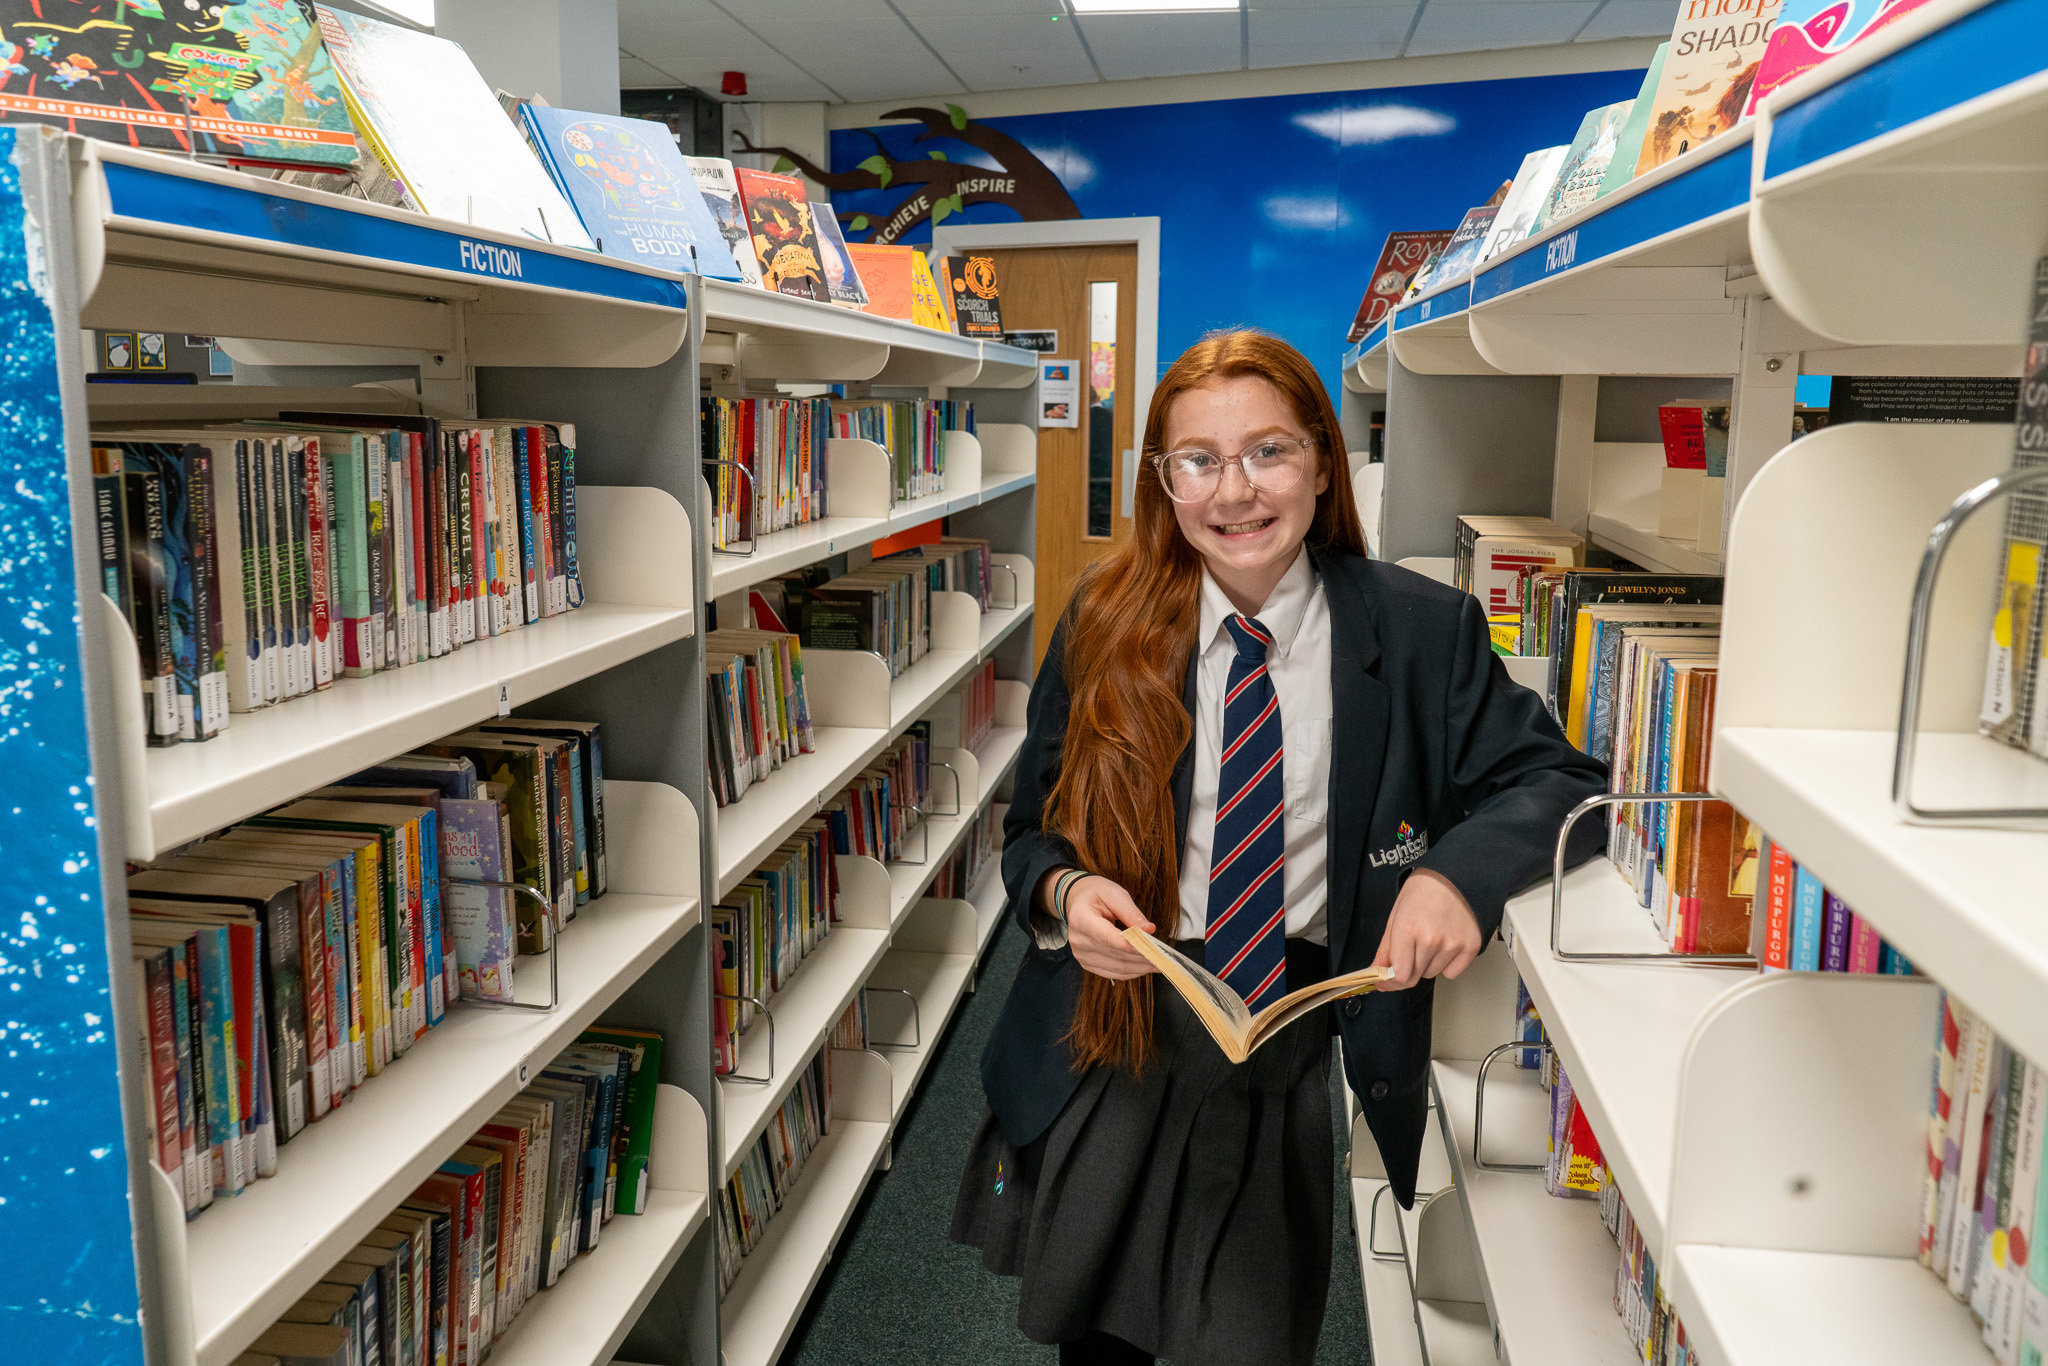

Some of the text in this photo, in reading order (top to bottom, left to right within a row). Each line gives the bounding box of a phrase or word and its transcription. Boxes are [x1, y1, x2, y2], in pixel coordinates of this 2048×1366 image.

[179, 47, 252, 70] COMICS
[37, 101, 66, 114] ART
[73, 106, 168, 125] SPIEGELMAN
[174, 118, 185, 127] &
[273, 128, 319, 141] MOULY
[690, 166, 724, 179] OMORROW
[956, 178, 1016, 197] INSPIRE
[624, 223, 697, 241] HUMAN
[874, 195, 931, 245] ACHIEVE
[1463, 219, 1475, 230] the
[459, 240, 522, 278] FICTION
[631, 237, 692, 257] BODY
[774, 250, 813, 265] SERAFINA
[1545, 230, 1578, 273] FICTION
[957, 298, 989, 312] SCORCH
[970, 310, 999, 324] TRIALS
[370, 444, 379, 497] DAVID ALMOND
[550, 460, 560, 515] Reckoning
[98, 489, 114, 519] ISAAC
[327, 491, 335, 521] ASIMOV
[460, 472, 472, 557] CREWEL
[564, 448, 578, 579] RTEMIS FOW
[101, 521, 117, 560] ASIMOV
[1491, 547, 1557, 557] THE JOSHUA FILES
[373, 550, 381, 596] JACKDAW
[1607, 585, 1687, 596] LLEWELYN JONES
[198, 591, 210, 636] Winter
[315, 590, 326, 619] FIRE
[201, 637, 211, 650] of
[201, 653, 211, 673] the
[501, 686, 508, 702] A
[1659, 669, 1674, 842] HIGH-RISE MYTERY
[533, 774, 546, 892] Rachel Campbell-Johnston
[559, 795, 574, 874] City of Glass
[366, 858, 379, 941] APPLE RAIN
[1769, 874, 1786, 962] MORPURGO
[1800, 884, 1816, 971] MORPURGO
[1828, 897, 1845, 973] ORPURG
[520, 1067, 527, 1081] C
[616, 1059, 628, 1091] FIRE
[599, 1082, 611, 1152] Gathering Light
[515, 1129, 528, 1215] CHARLES DICKENS
[471, 1251, 480, 1281] GIRL
